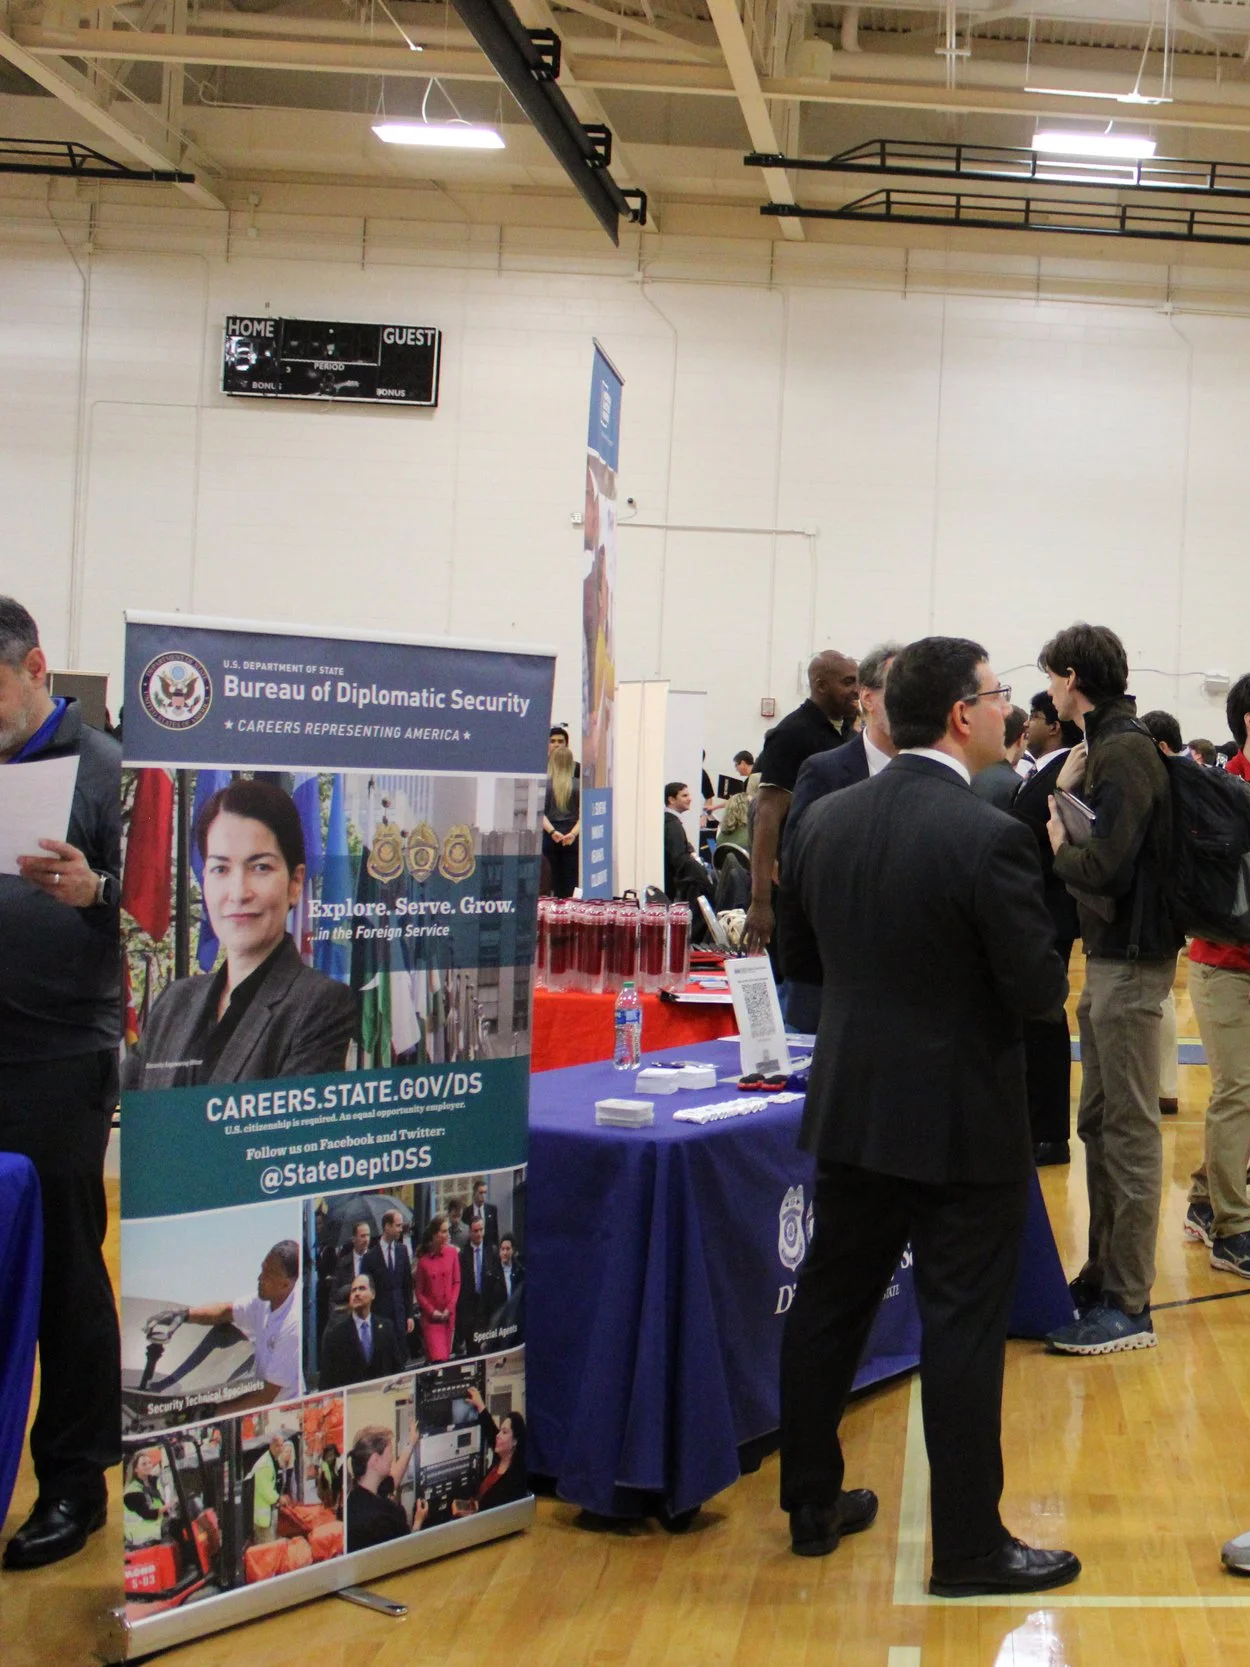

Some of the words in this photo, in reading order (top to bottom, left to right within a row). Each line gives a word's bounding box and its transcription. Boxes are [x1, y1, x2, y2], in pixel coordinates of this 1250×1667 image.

[228, 319, 275, 337] HOME
[384, 328, 435, 346] GUEST
[314, 362, 345, 371] PERIOD
[223, 660, 241, 669] U.S.
[243, 661, 303, 673] DEPARTMENT
[306, 665, 317, 674] OF
[319, 666, 344, 676] STATE
[224, 675, 305, 701] Bureau
[311, 681, 331, 702] of
[336, 682, 446, 709] Diplomatic
[450, 689, 530, 717] Security
[237, 719, 301, 734] CAREERS
[304, 722, 401, 739] REPRESENTING
[404, 727, 460, 741] AMERICA
[308, 898, 391, 921] Explore.
[395, 897, 456, 916] Serve.
[460, 896, 516, 914] Grow.
[332, 927, 352, 940] the
[355, 925, 402, 941] Foreign
[404, 923, 450, 938] Service
[206, 1072, 483, 1122] CAREERS.STATE.GOV/DS
[225, 1125, 242, 1135] U.S.
[244, 1120, 291, 1133] citizenship
[292, 1118, 299, 1127] is
[300, 1114, 338, 1127] required.
[352, 1109, 376, 1120] equal
[377, 1104, 425, 1118] opportunity
[426, 1101, 466, 1112] employer.
[246, 1146, 287, 1161] Follow
[289, 1145, 302, 1155] us
[304, 1142, 318, 1152] on
[319, 1133, 375, 1150] Facebook
[376, 1130, 397, 1143] and
[398, 1128, 446, 1141] Twitter:
[260, 1145, 432, 1194] @StateDeptDSS
[147, 1398, 184, 1415] Security
[185, 1389, 222, 1407] Technical
[222, 1380, 265, 1398] Specialists
